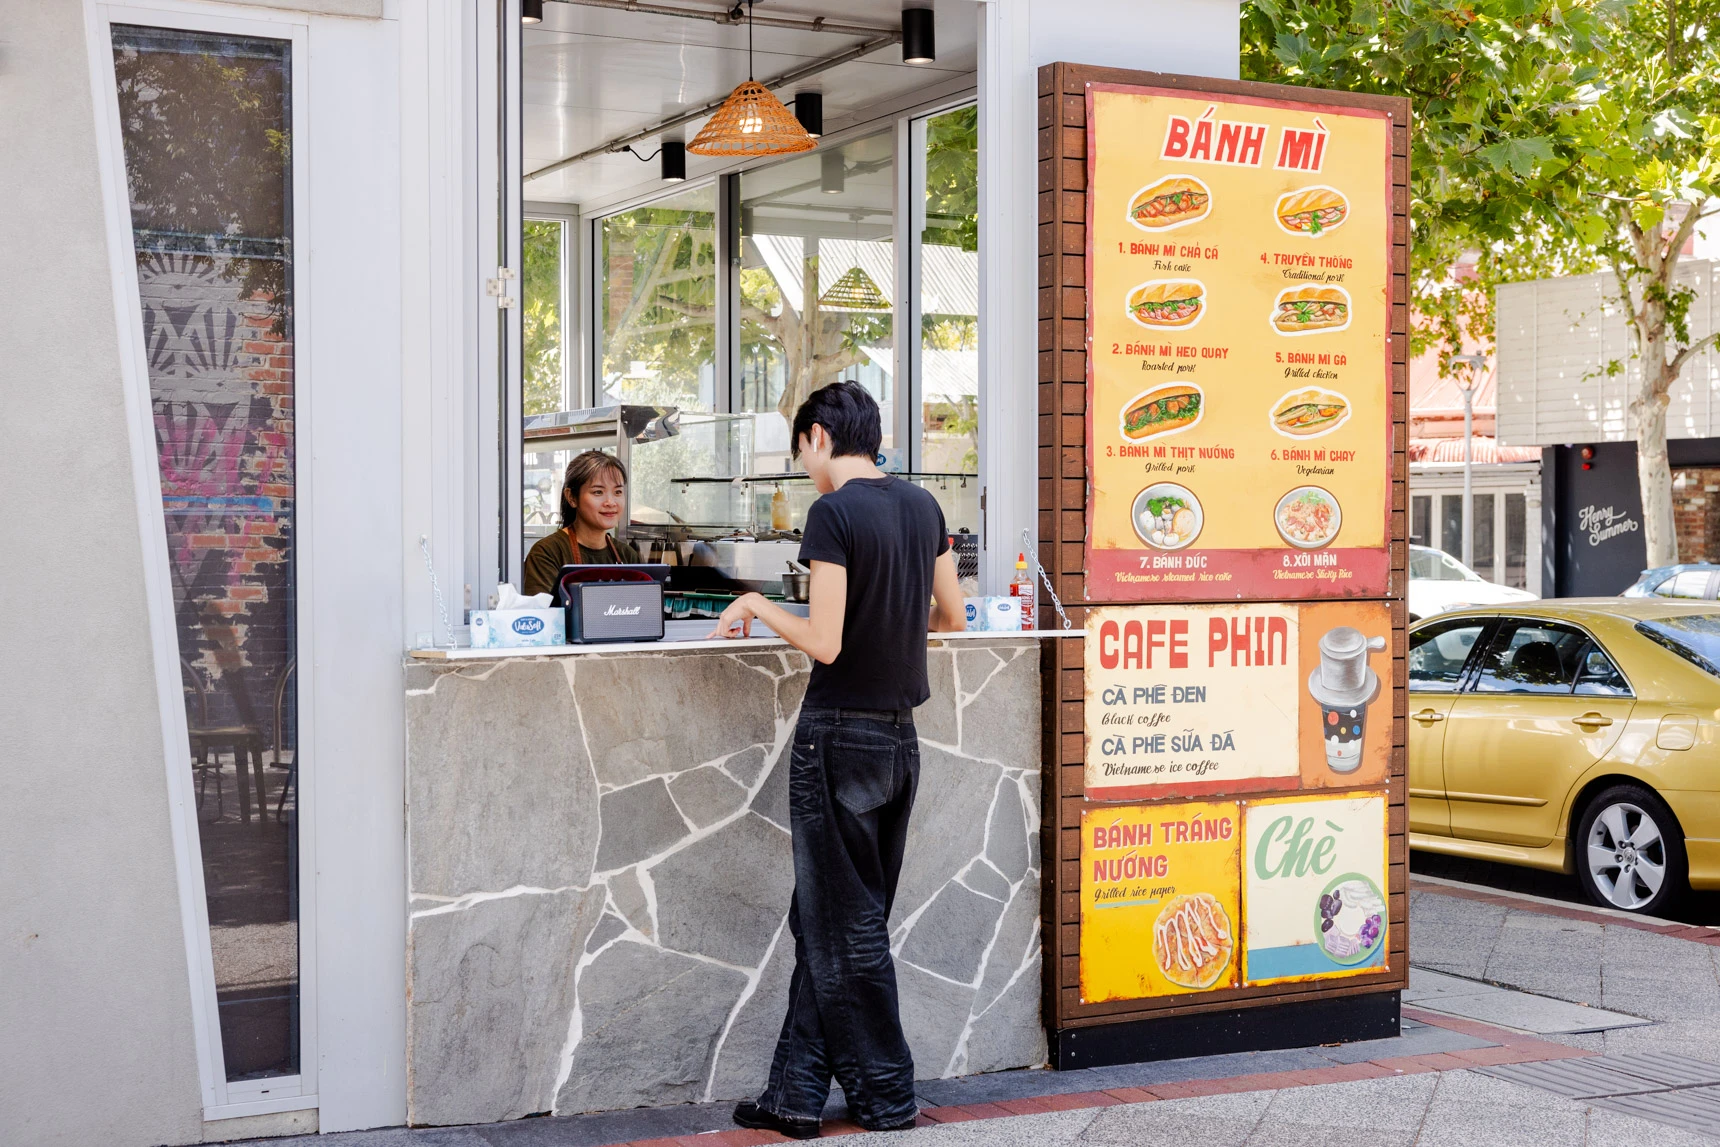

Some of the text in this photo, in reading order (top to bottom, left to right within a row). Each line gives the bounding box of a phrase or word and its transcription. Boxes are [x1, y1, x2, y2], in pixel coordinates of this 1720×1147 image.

[1162, 105, 1328, 171] BÁNH MÌ
[1118, 242, 1126, 253] 1.
[1130, 239, 1160, 256] BÁNH
[1163, 242, 1177, 257] MÌ
[1205, 245, 1219, 260] CÁ
[1153, 260, 1191, 272] Fish cake
[1260, 252, 1353, 269] 4. TRUYỀN THỐNG
[1282, 269, 1345, 283] Traditional pork
[1112, 340, 1229, 359] 2. BÁNH MÌ HEO QUAY
[1275, 352, 1284, 363] 5.
[1141, 360, 1196, 374] Roasted pork
[1284, 367, 1338, 379] Grilled chicken
[1106, 445, 1116, 457] 3.
[1119, 442, 1149, 457] BÁNH
[1153, 442, 1166, 458] MÌ
[1170, 446, 1195, 461] THỊT
[1271, 446, 1356, 462] 6. BÁNH MÌ CHAY
[1145, 462, 1195, 475] Grilled pork
[1296, 465, 1334, 476] Vegetarian
[1579, 505, 1627, 531] Henry
[1589, 518, 1638, 546] Summer
[1140, 552, 1207, 569] 7. BÁNH ĐÚC
[1115, 571, 1232, 583] Vietnamese steamed rice cake
[1273, 568, 1352, 583] Vietnamese Sticky Rice
[603, 604, 641, 616] Marshall
[1100, 616, 1288, 669] CAFE PHIN
[1102, 684, 1206, 705] CÀ PHÊ ĐEN
[1101, 712, 1171, 727] Black coffee
[1101, 728, 1235, 756] CÀ PHÊ SỮA ĐÁ
[1102, 760, 1219, 776] Vietnamese ice coffee
[1093, 812, 1233, 850] BÁNH TRÁNG
[1254, 815, 1344, 881] Chè
[1093, 850, 1168, 884] NƯỚNG
[1094, 886, 1176, 902] Grilled rice paper
